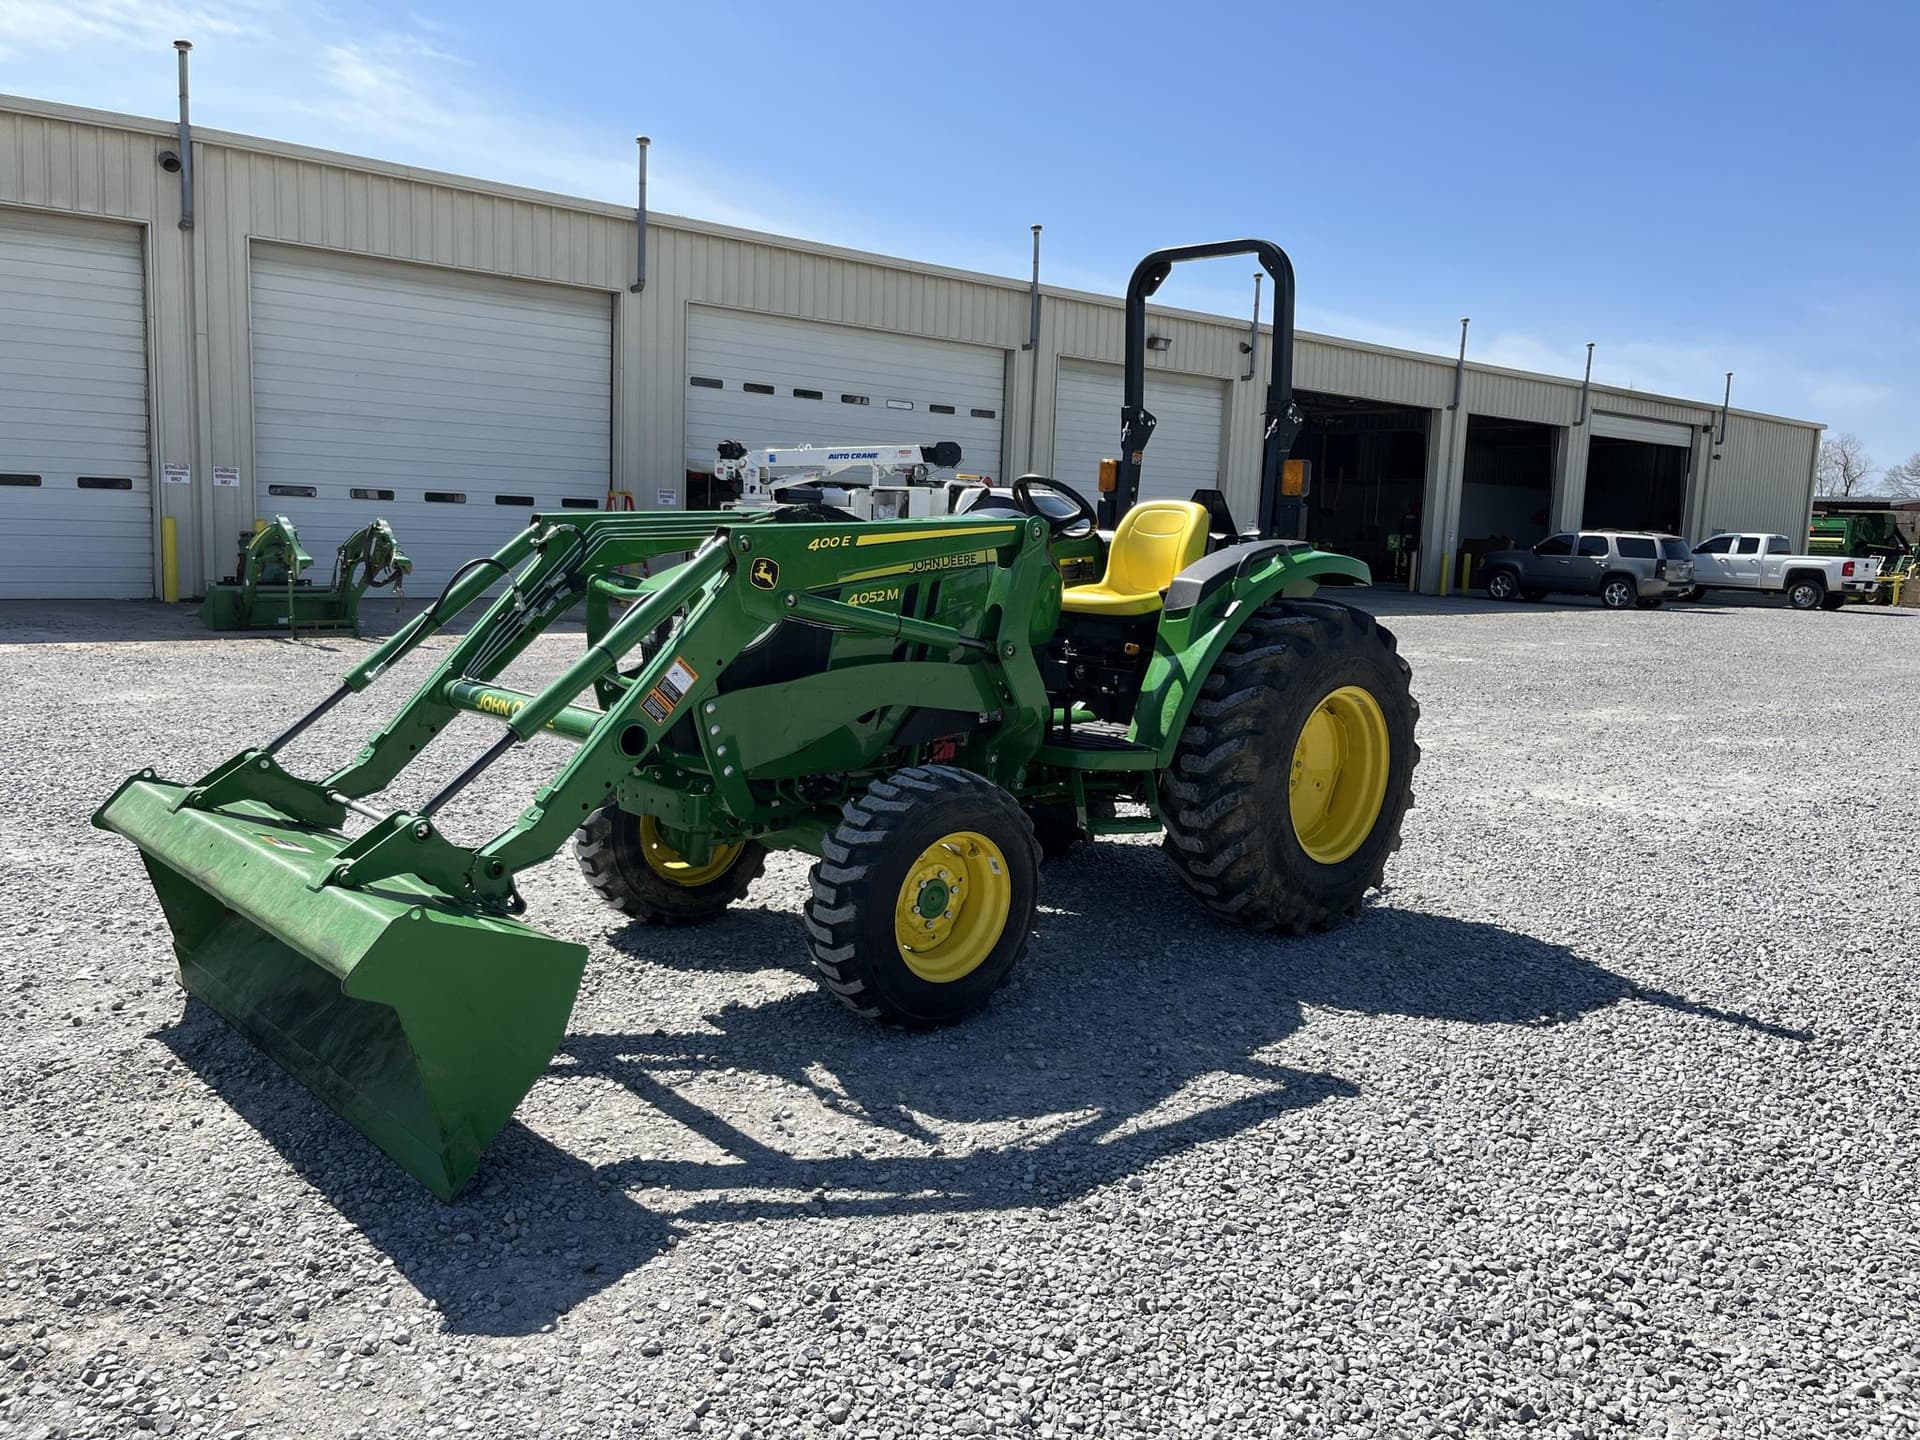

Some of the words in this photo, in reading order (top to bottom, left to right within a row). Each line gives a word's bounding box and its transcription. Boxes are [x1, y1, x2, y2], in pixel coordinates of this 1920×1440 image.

[908, 558, 941, 573] JOHN
[942, 554, 977, 569] DEERE
[476, 692, 511, 716] JOHN
